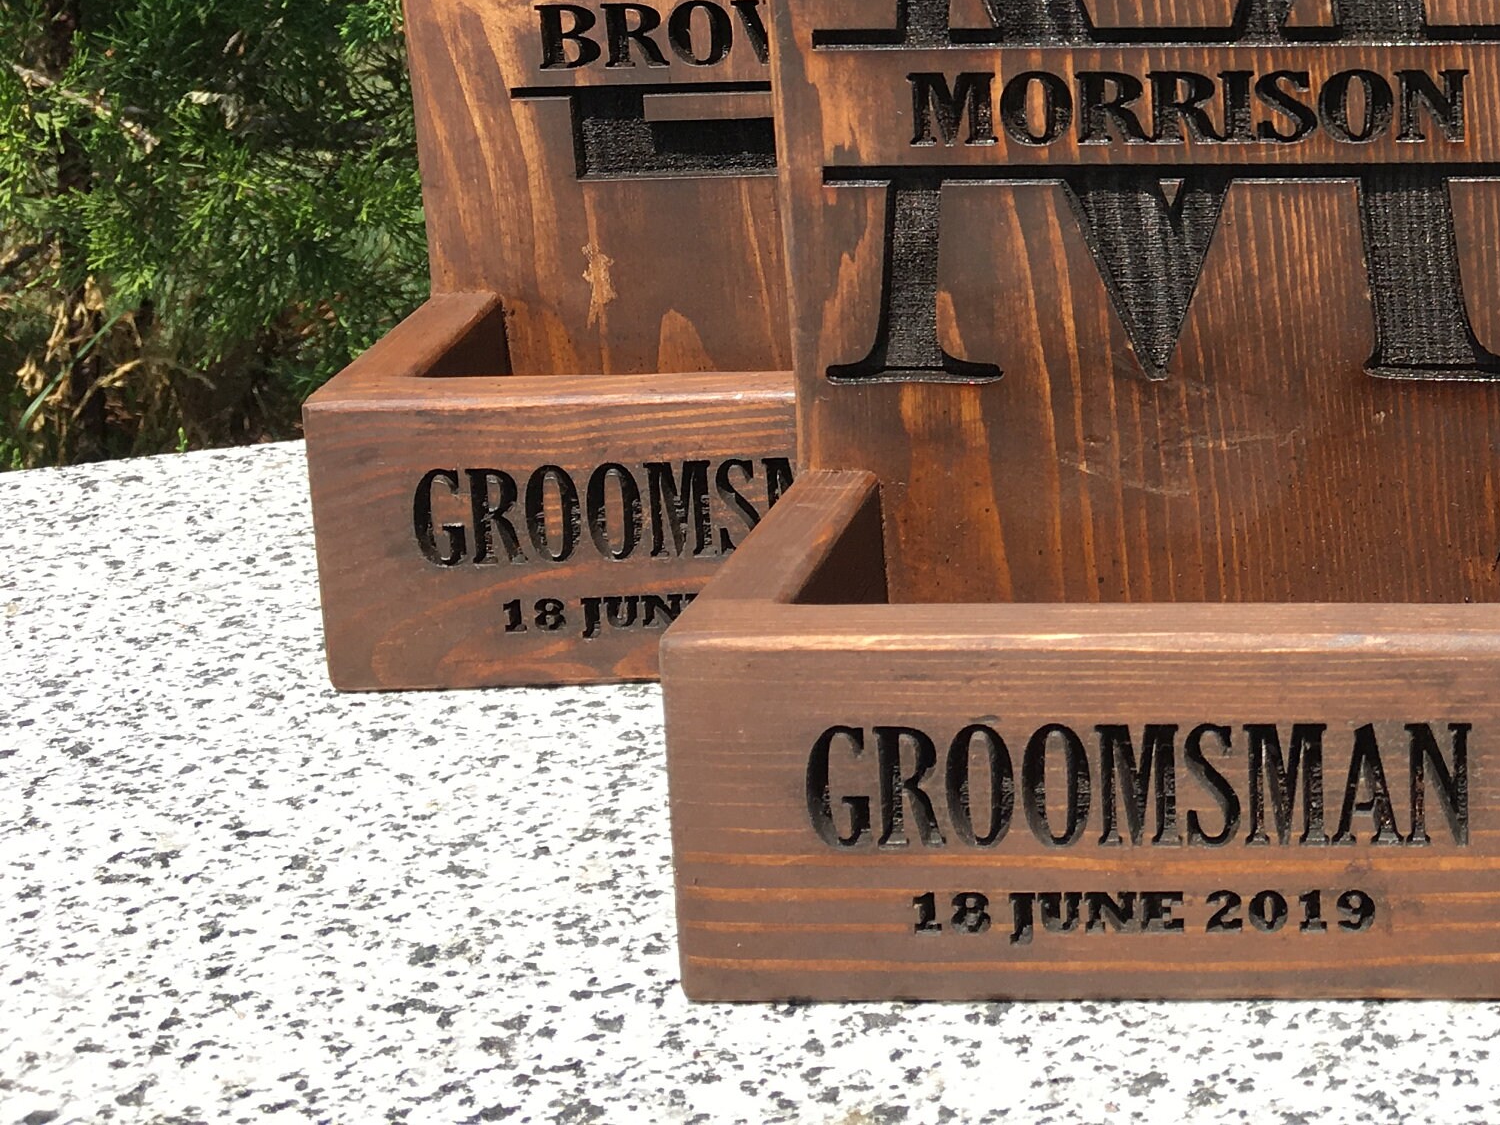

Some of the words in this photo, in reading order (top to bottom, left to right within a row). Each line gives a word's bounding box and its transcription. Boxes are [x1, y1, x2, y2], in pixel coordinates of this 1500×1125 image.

[906, 69, 1470, 147] MORRISON
[503, 598, 566, 633] 18
[580, 593, 699, 640] JUN
[806, 722, 1473, 849] GROOMSMAN
[912, 891, 992, 934] 18
[1009, 890, 1185, 946] JUNE
[1205, 889, 1377, 933] 2019
